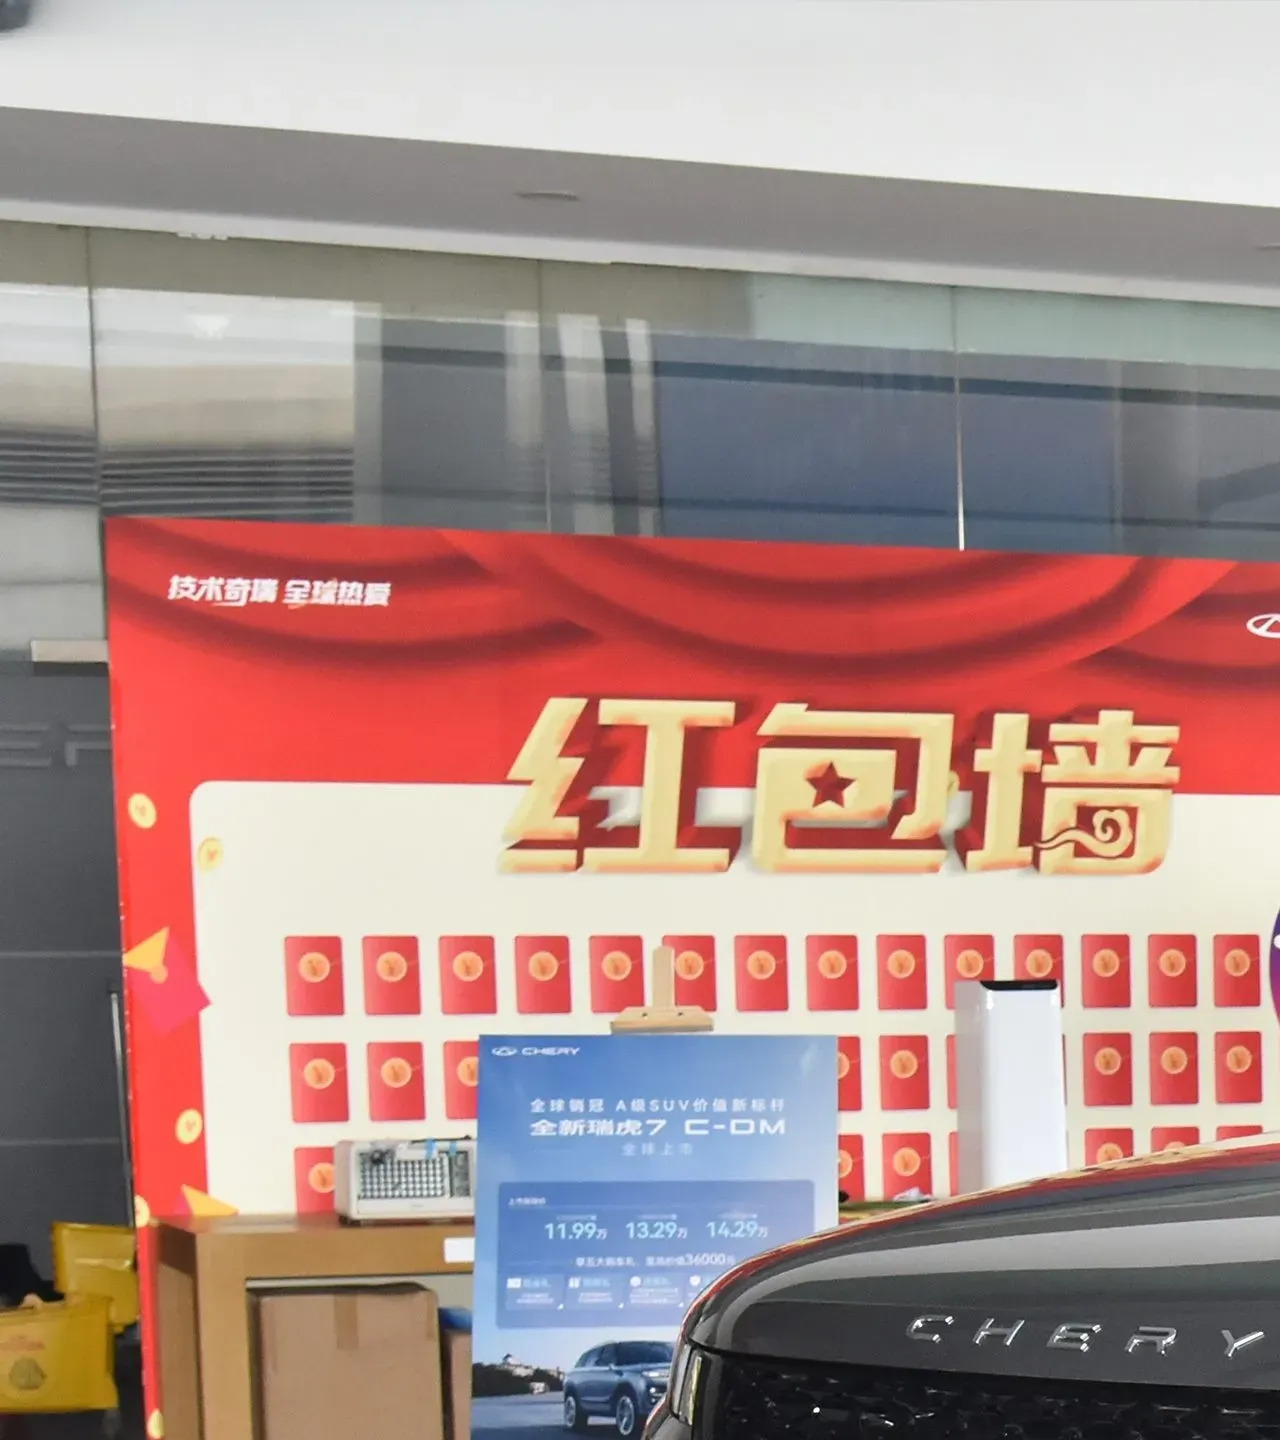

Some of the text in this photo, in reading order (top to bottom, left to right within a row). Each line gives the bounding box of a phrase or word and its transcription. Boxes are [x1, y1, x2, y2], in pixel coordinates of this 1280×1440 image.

[498, 696, 1182, 875] 红包墙
[521, 1046, 580, 1057] CHERY
[530, 1118, 786, 1137] 全新瑞虎7 C-DM
[906, 1315, 1265, 1358] CHERY
